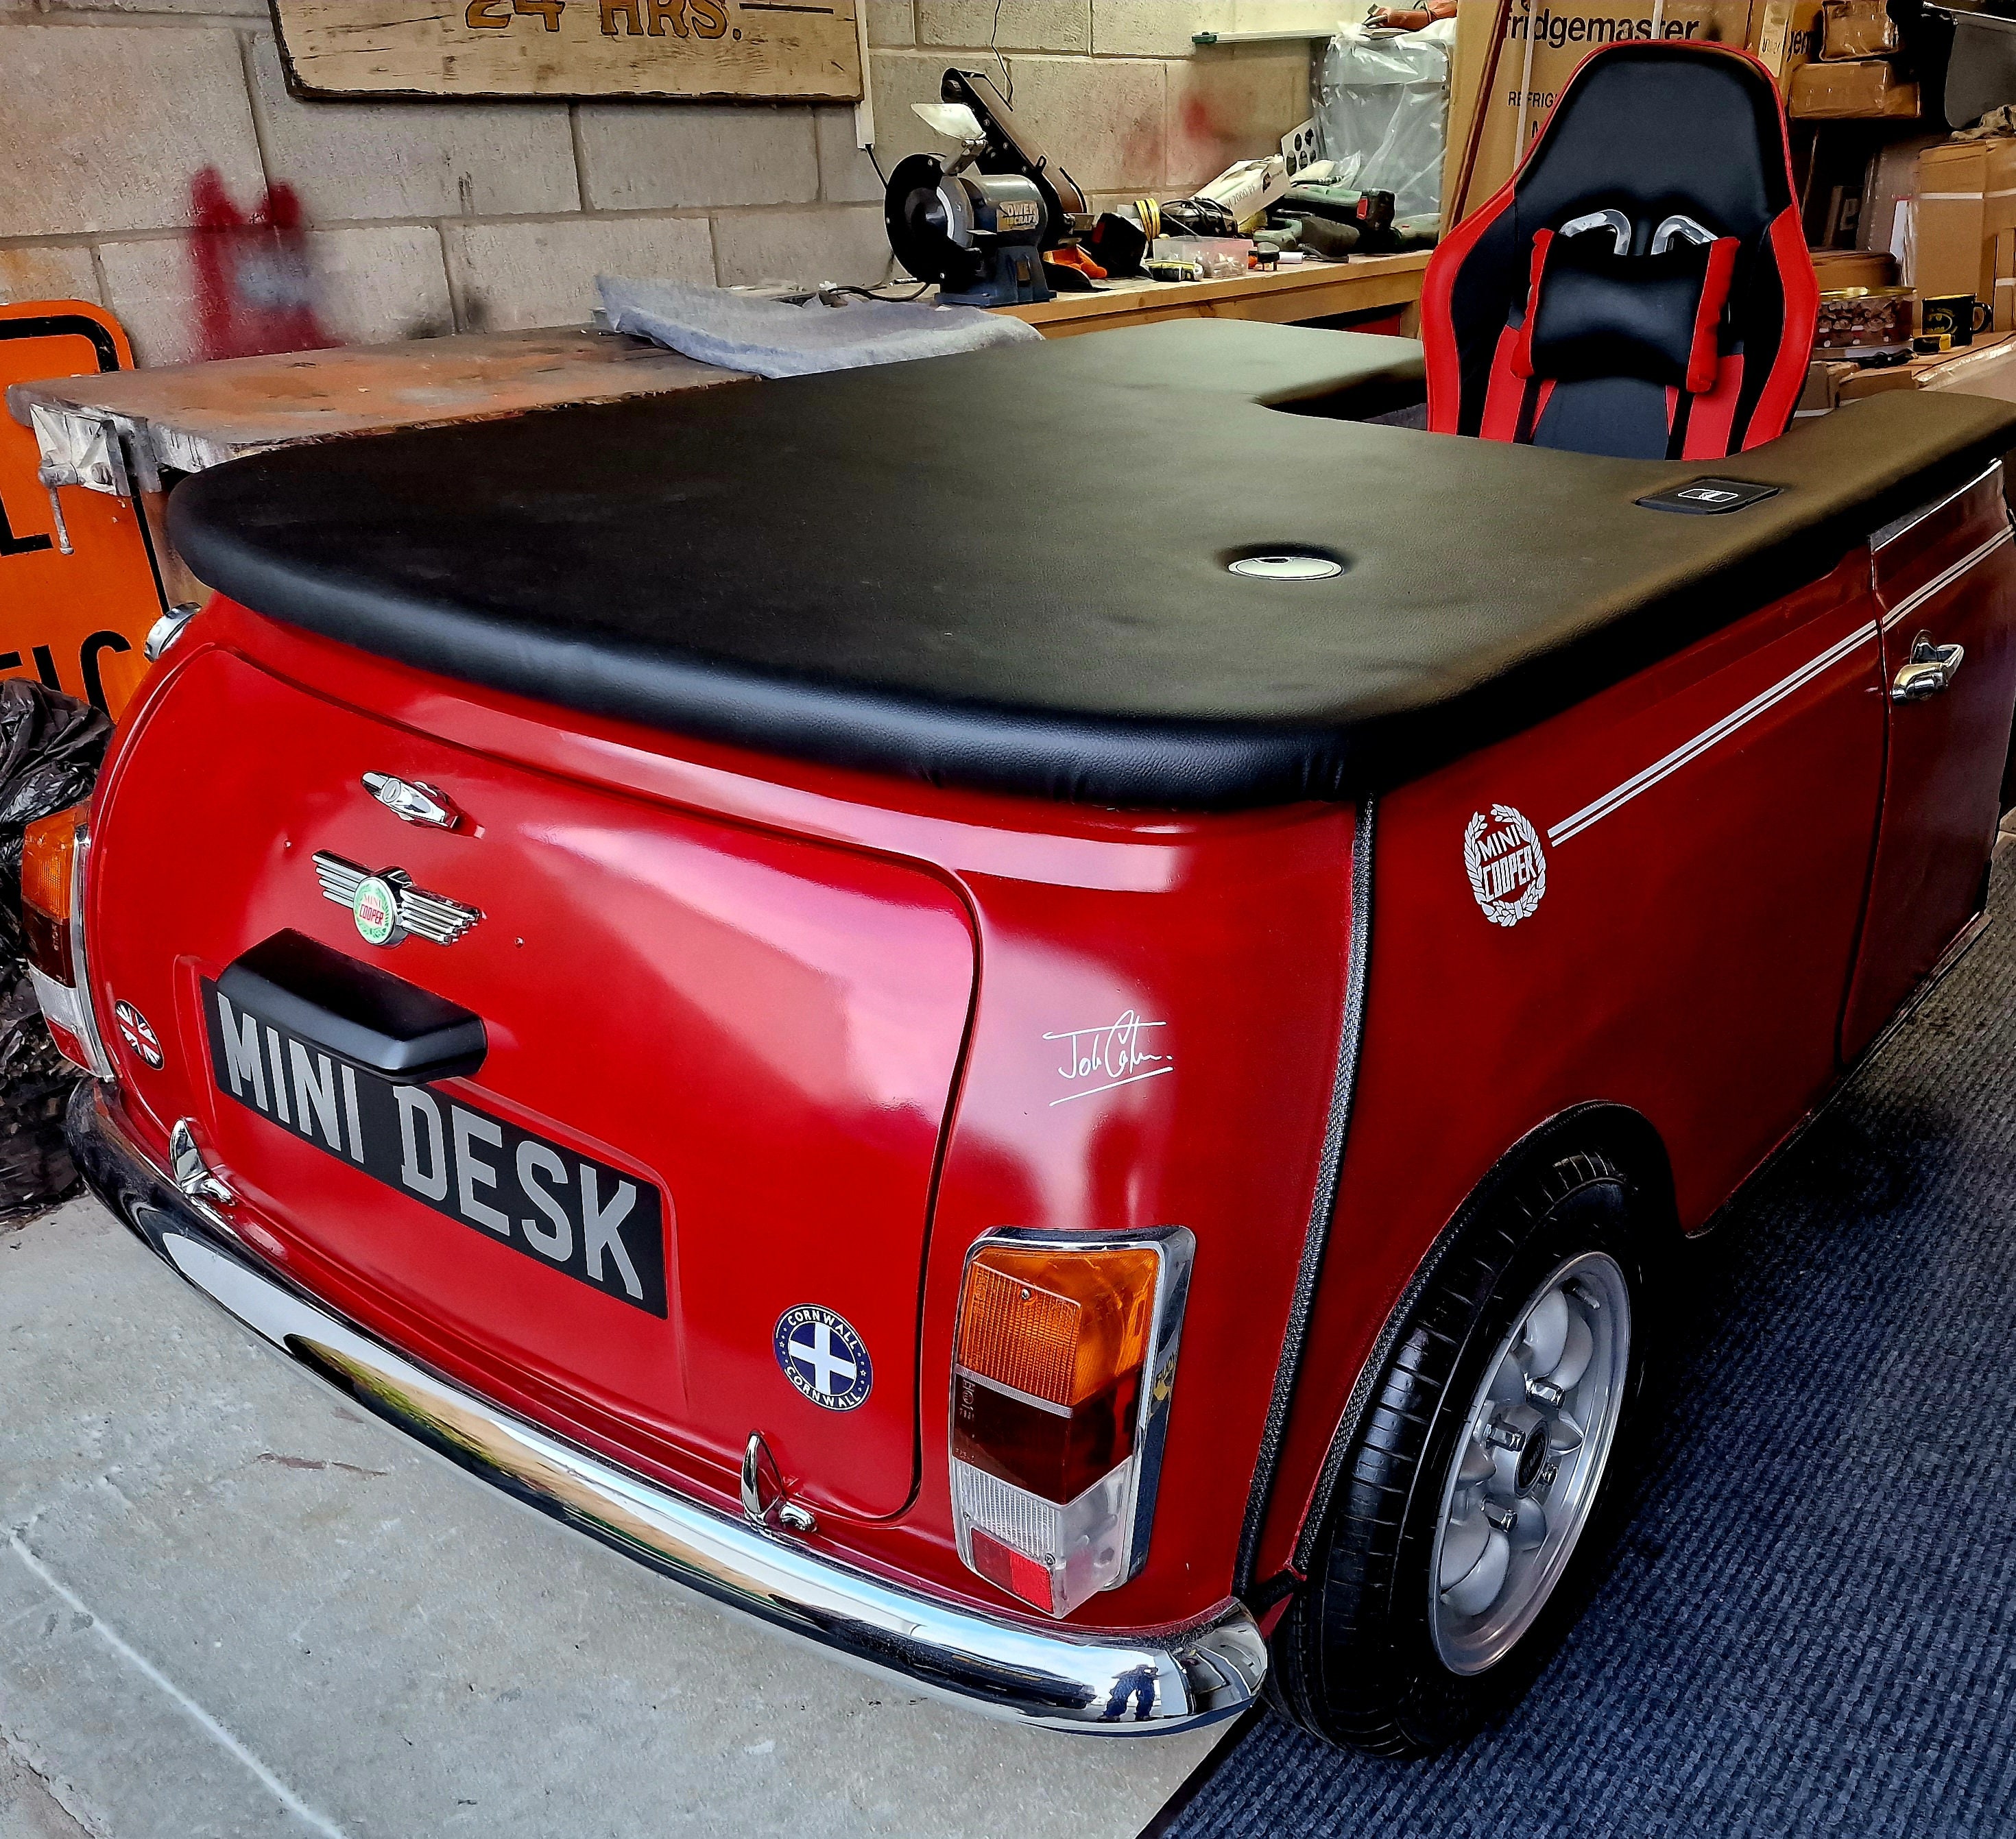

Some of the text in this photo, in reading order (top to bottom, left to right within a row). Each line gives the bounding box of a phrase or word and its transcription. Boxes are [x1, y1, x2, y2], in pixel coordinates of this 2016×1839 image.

[1505, 8, 1700, 49] ridgemaser
[1476, 824, 1521, 862] MINI
[1482, 844, 1537, 903] COOPER
[359, 903, 385, 926] COOPER
[362, 893, 383, 909] MINI
[217, 991, 643, 1301] MINI DESK
[787, 1309, 859, 1350] CORNWALL
[786, 1365, 861, 1408] CORNWALL
